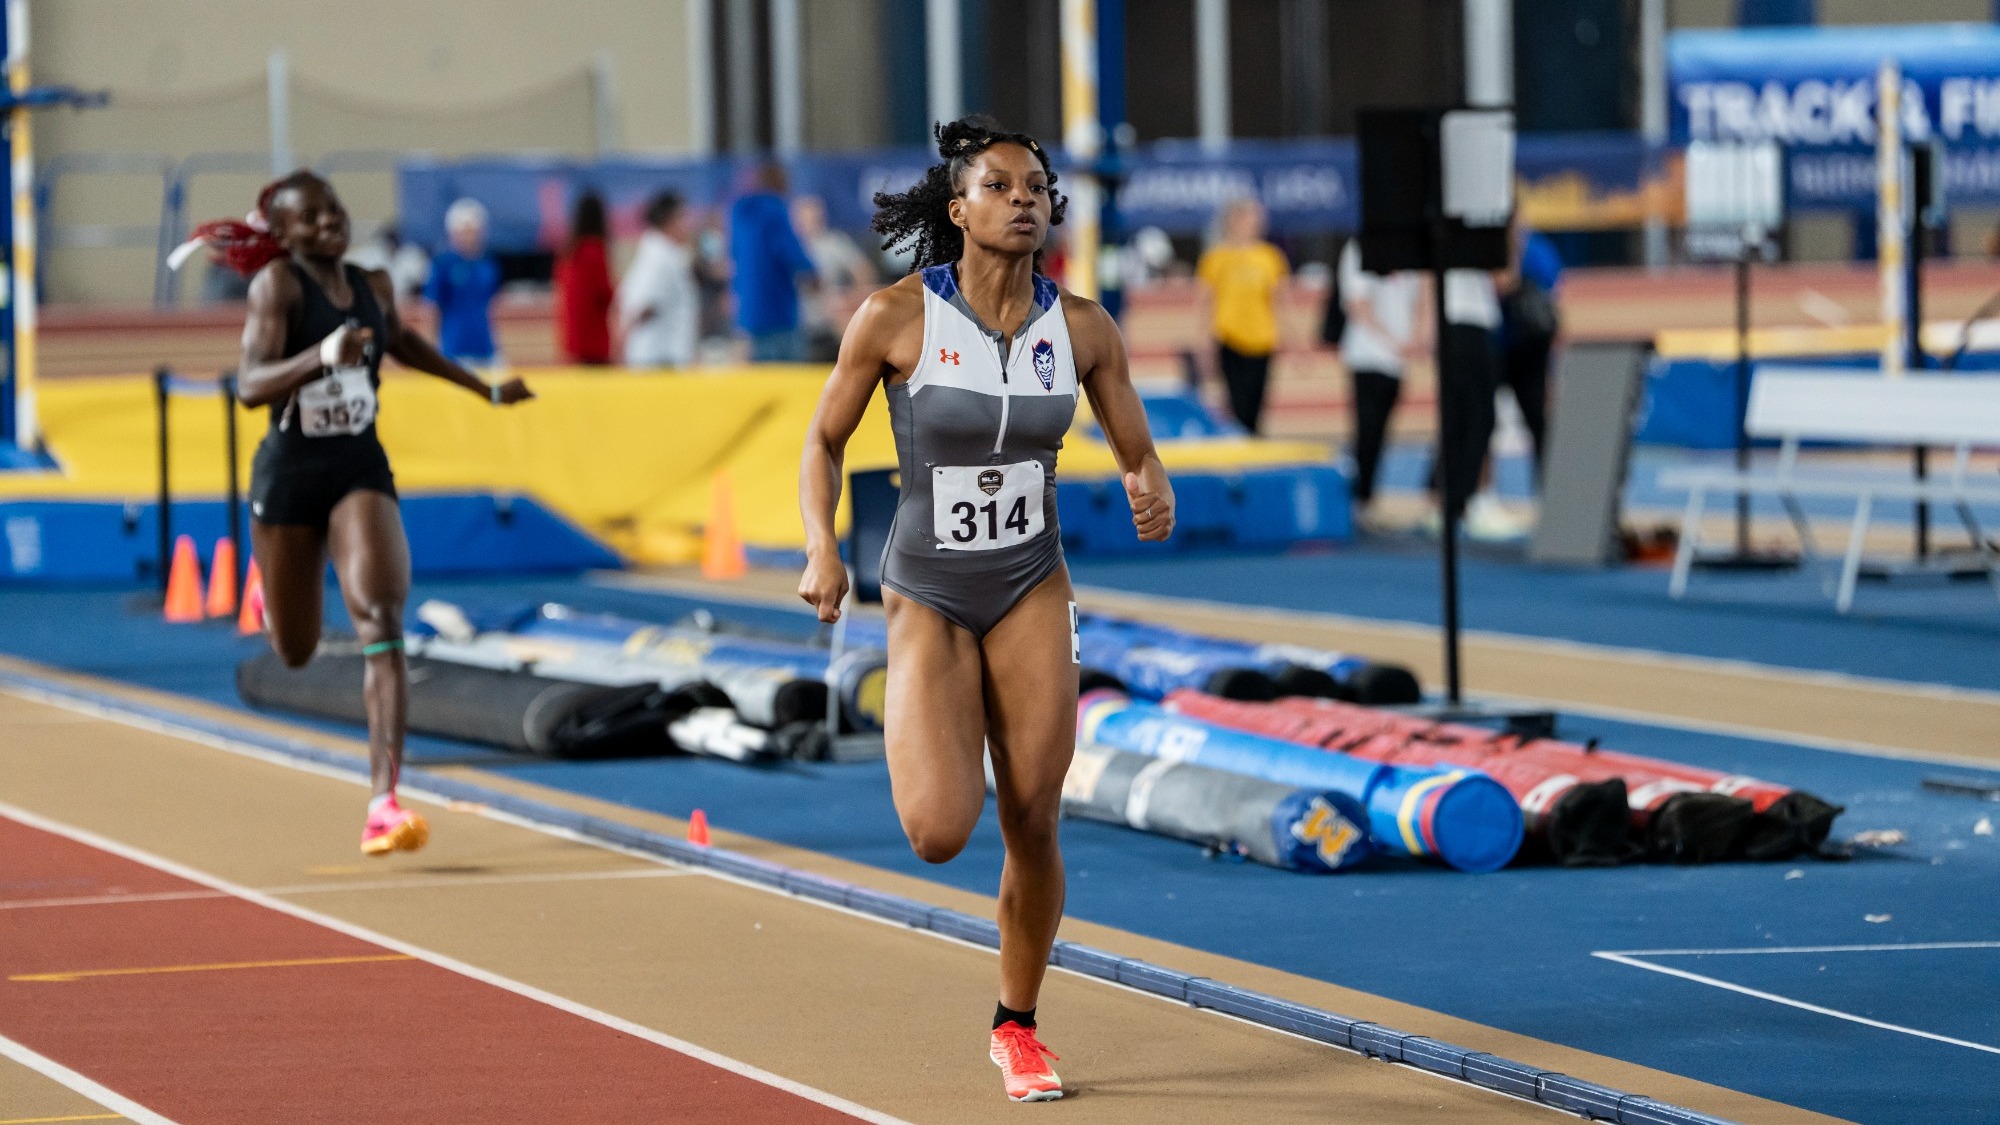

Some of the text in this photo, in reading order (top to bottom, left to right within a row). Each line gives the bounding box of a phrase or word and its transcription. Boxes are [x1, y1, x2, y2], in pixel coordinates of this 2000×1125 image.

[1678, 80, 1879, 144] TRACK
[314, 398, 366, 431] 352
[951, 496, 1029, 543] 314
